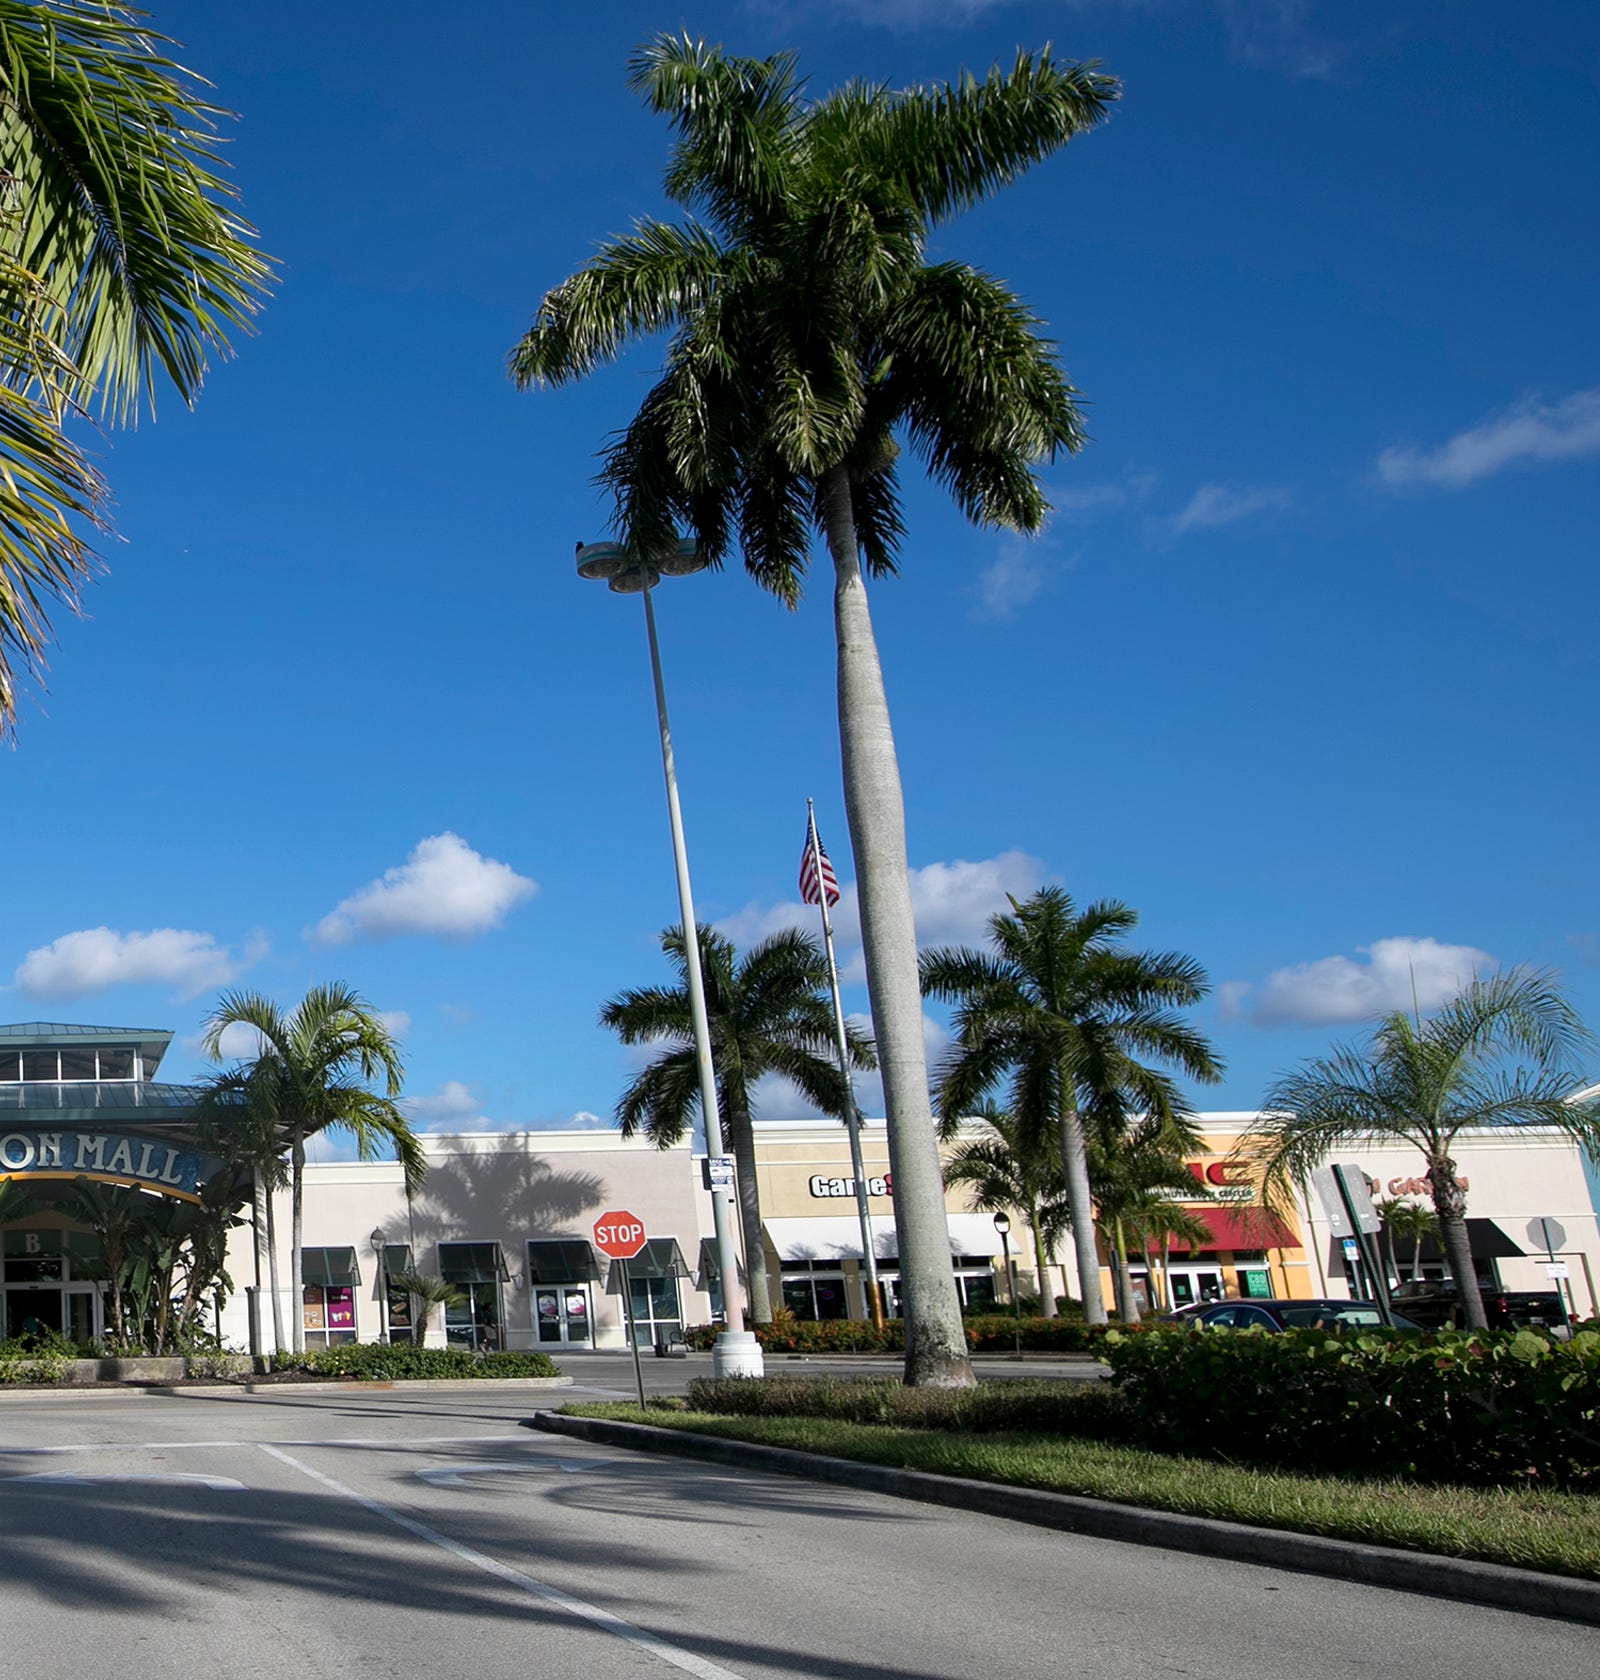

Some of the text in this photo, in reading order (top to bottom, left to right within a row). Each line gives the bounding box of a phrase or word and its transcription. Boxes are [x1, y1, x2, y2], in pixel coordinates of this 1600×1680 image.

[74, 1134, 183, 1185] MALL
[25, 1233, 41, 1253] B
[597, 1224, 642, 1244] STOP
